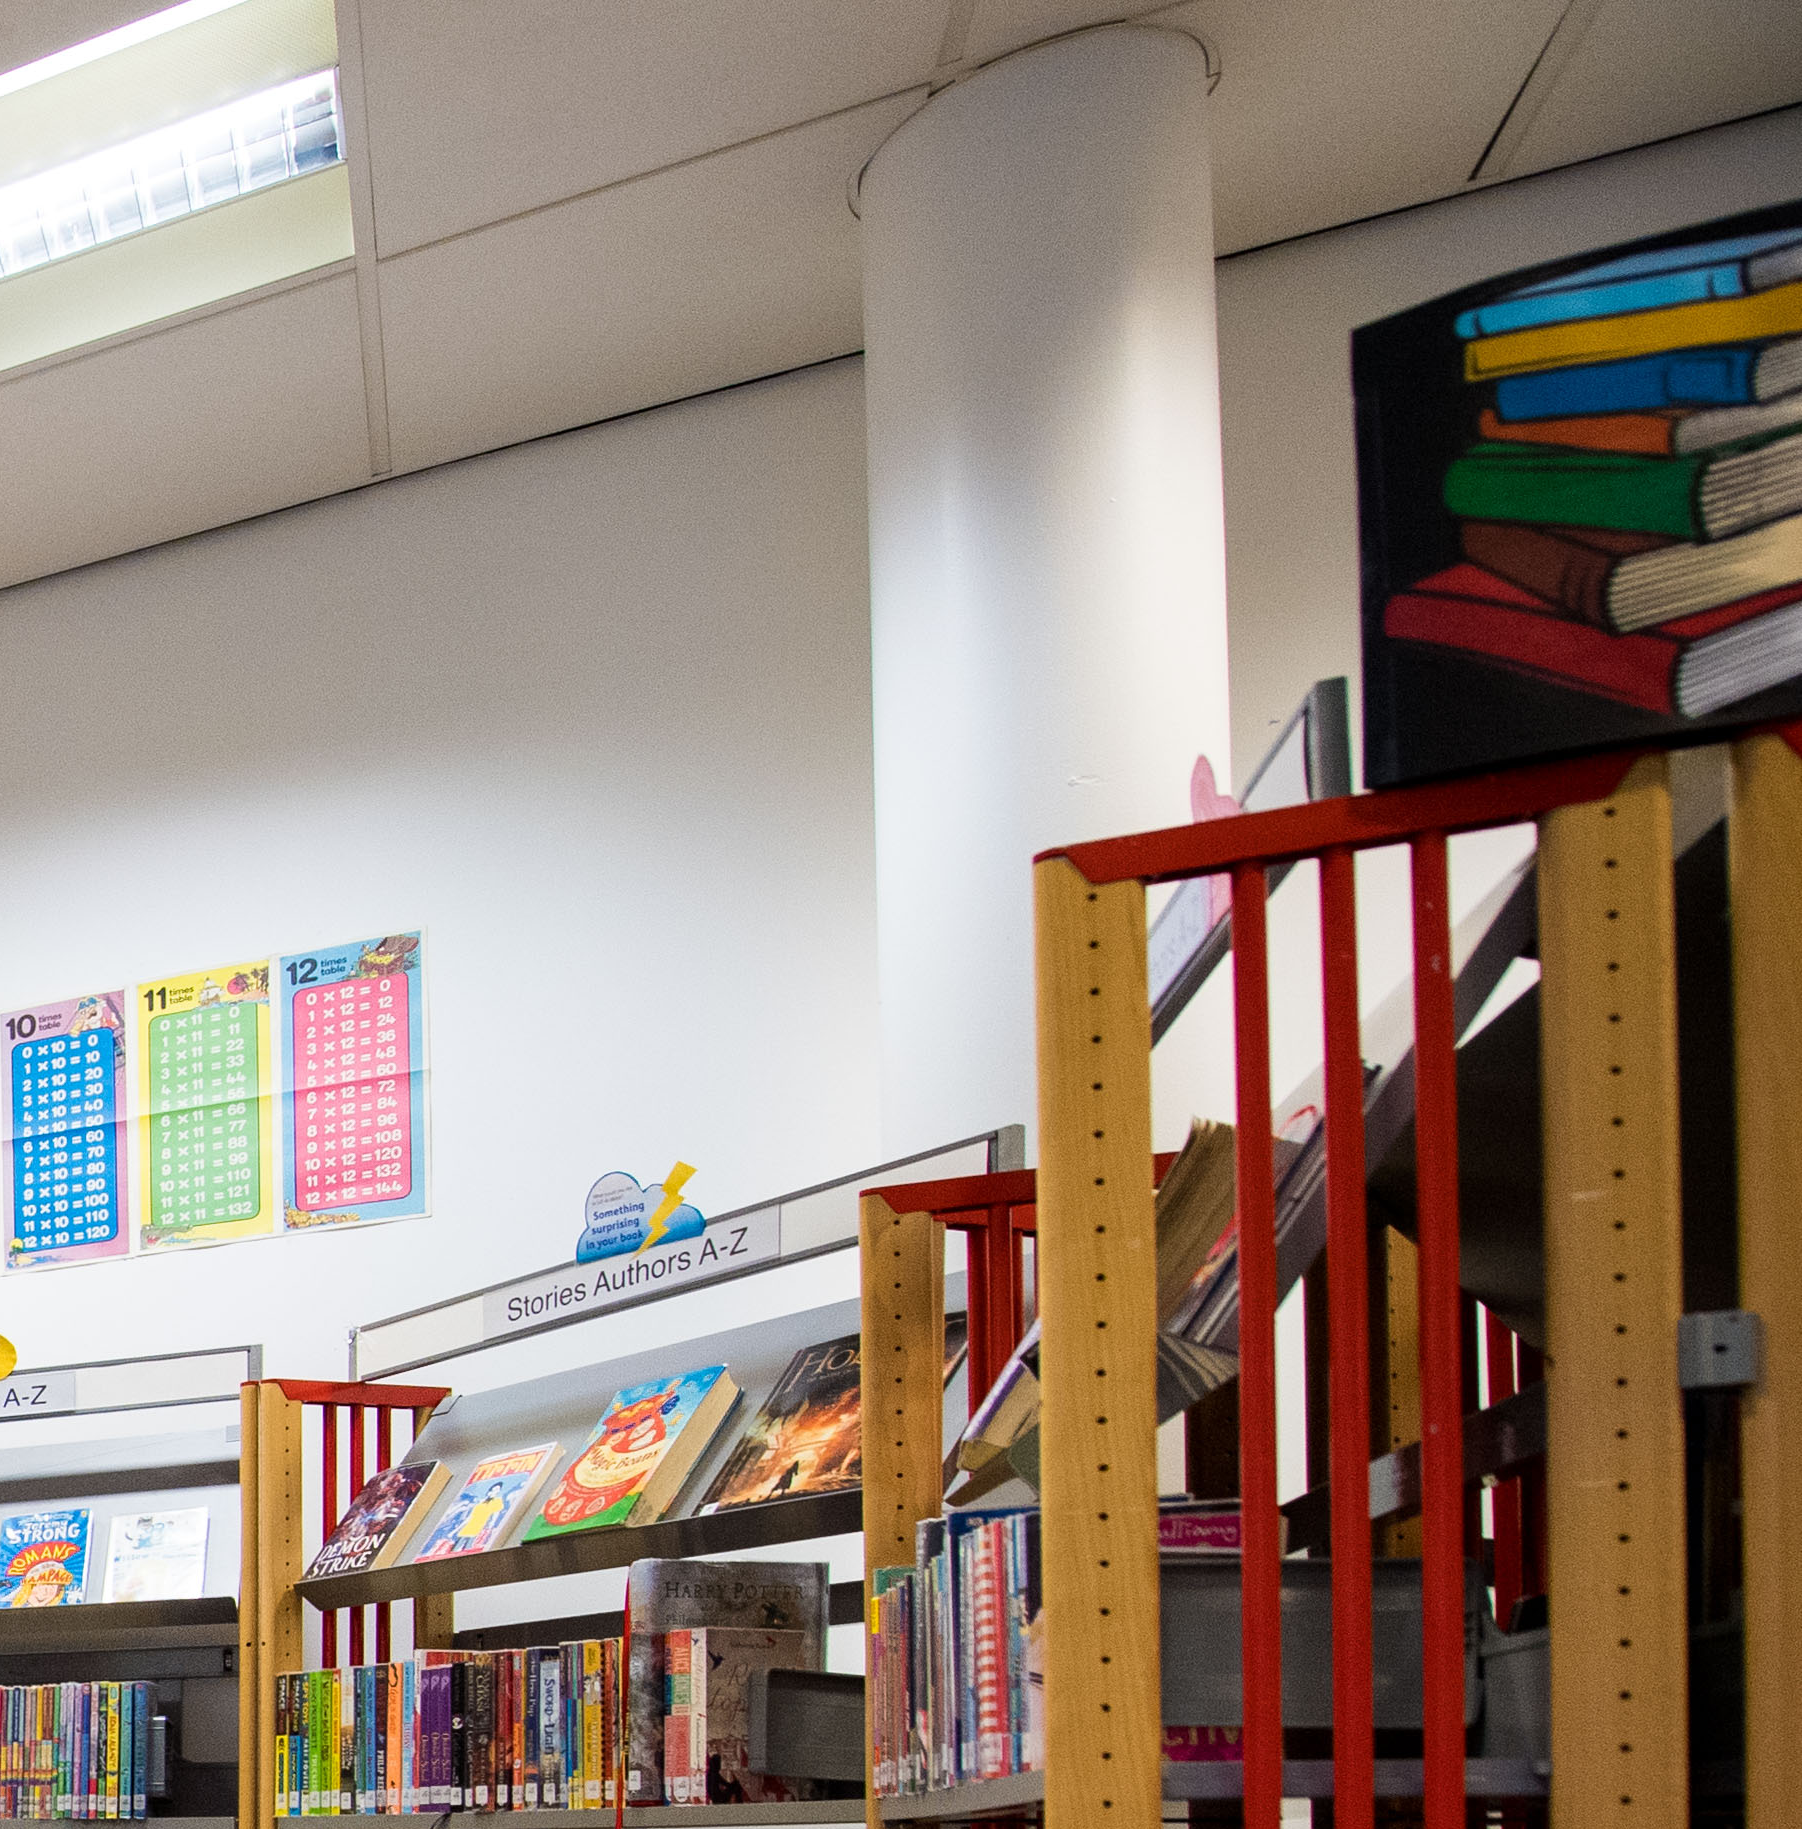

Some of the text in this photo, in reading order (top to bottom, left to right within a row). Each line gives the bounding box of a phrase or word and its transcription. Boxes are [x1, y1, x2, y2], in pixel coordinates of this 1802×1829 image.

[286, 958, 317, 985] 12
[321, 958, 347, 970] times
[321, 968, 346, 981] table
[144, 987, 167, 1012] 11
[6, 1015, 36, 1040] 10
[593, 1202, 644, 1219] Something
[592, 1218, 639, 1234] surprising
[586, 1230, 643, 1251] in your book
[508, 1227, 748, 1321] Stories Authors A-Z
[4, 1385, 48, 1408] A-Z
[5, 1523, 81, 1543] STRONG
[318, 1533, 385, 1559] DEMON
[8, 1544, 77, 1577] ROMANS
[307, 1551, 371, 1578] STRIKE
[665, 1582, 804, 1599] HARRY POTTER
